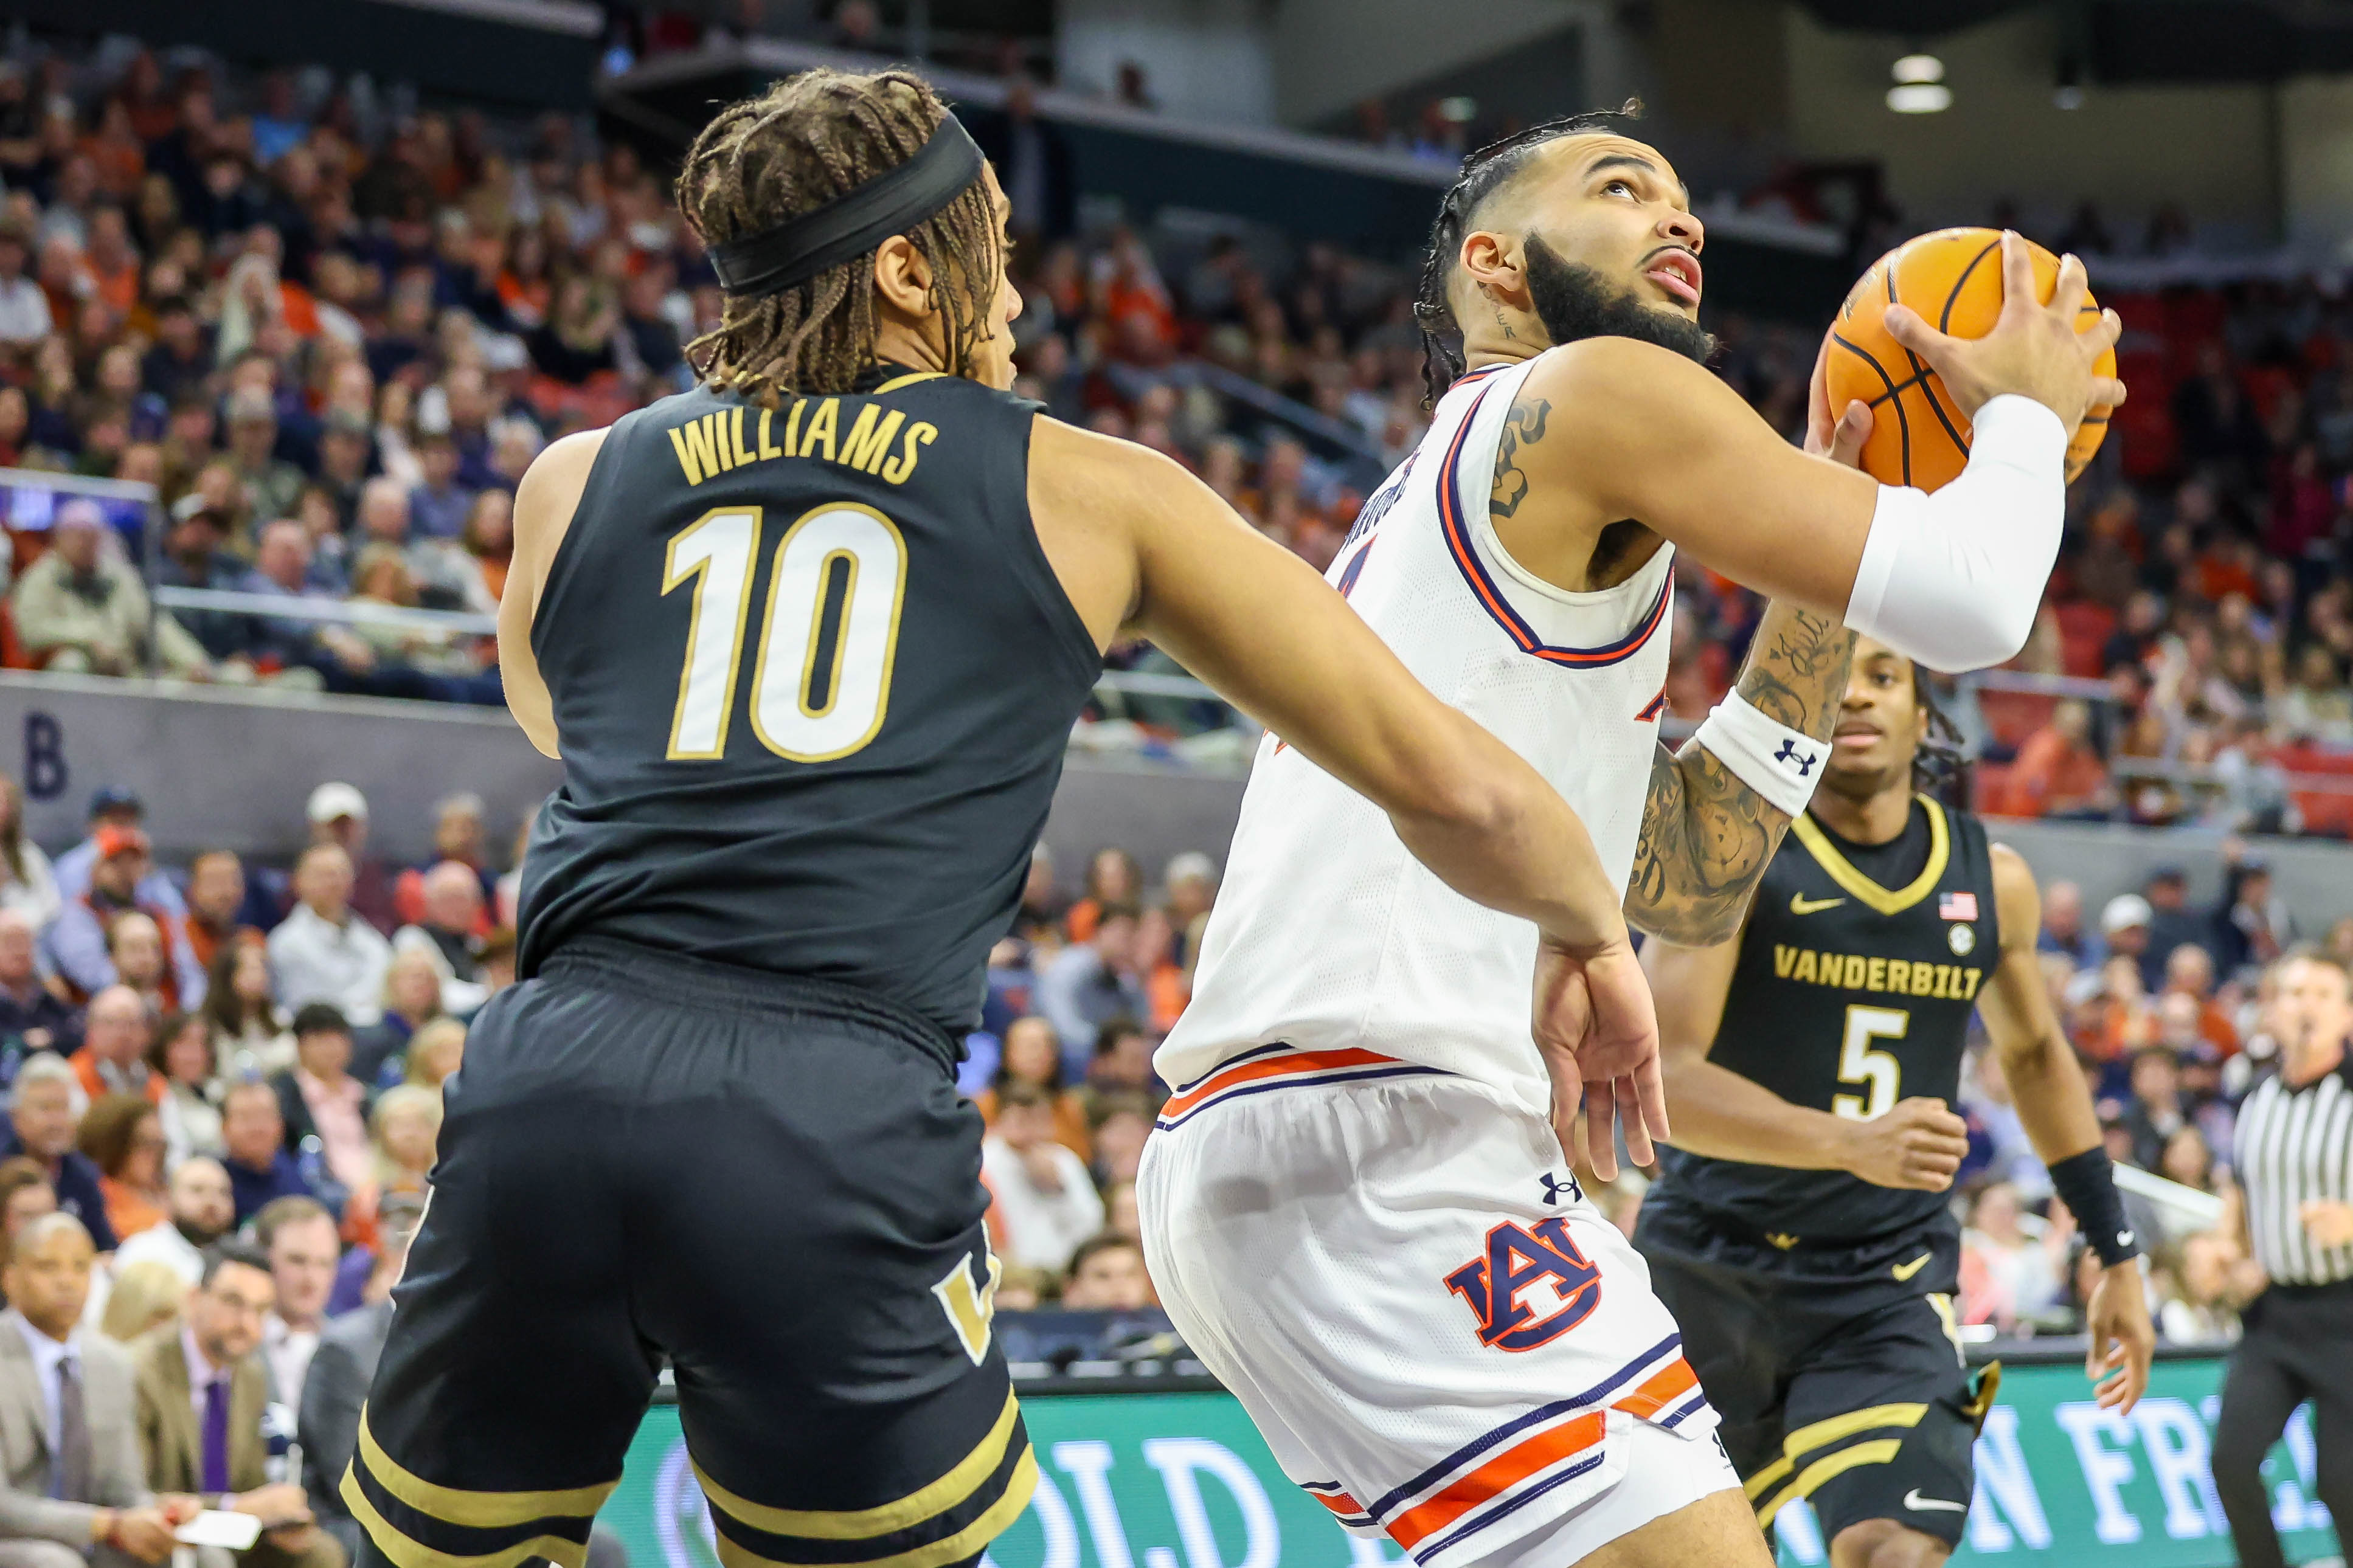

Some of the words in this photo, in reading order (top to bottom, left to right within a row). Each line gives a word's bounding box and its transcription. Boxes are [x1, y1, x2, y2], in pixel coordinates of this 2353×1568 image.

[668, 397, 938, 486] WILLIAMS
[660, 500, 909, 764] 10
[1773, 944, 1983, 1001] VANDERBILT
[1831, 1003, 1911, 1124] 5
